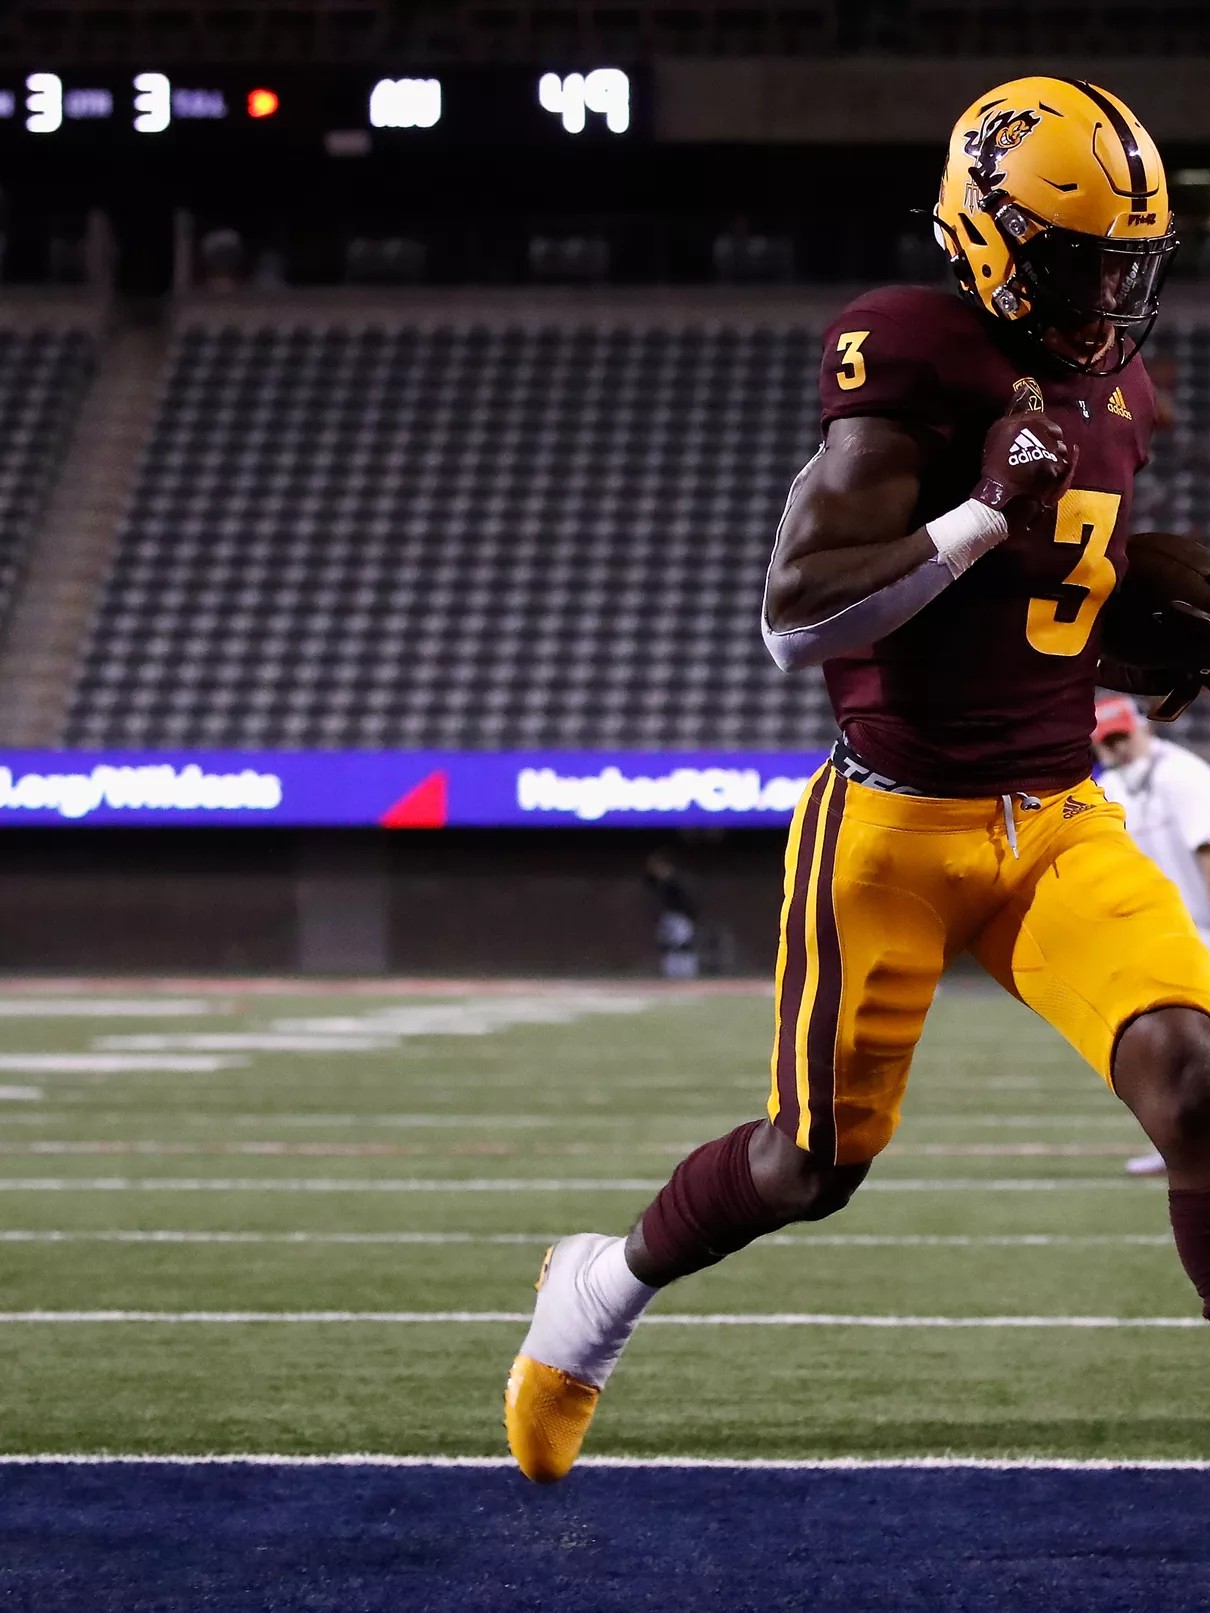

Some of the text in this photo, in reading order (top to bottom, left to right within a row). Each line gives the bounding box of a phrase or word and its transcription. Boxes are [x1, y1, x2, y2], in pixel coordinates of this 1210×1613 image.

[26, 73, 62, 132] 3
[133, 73, 170, 132] 3
[539, 69, 629, 133] 49
[836, 331, 870, 390] 3
[1008, 446, 1058, 466] adidas
[1026, 489, 1121, 657] 3
